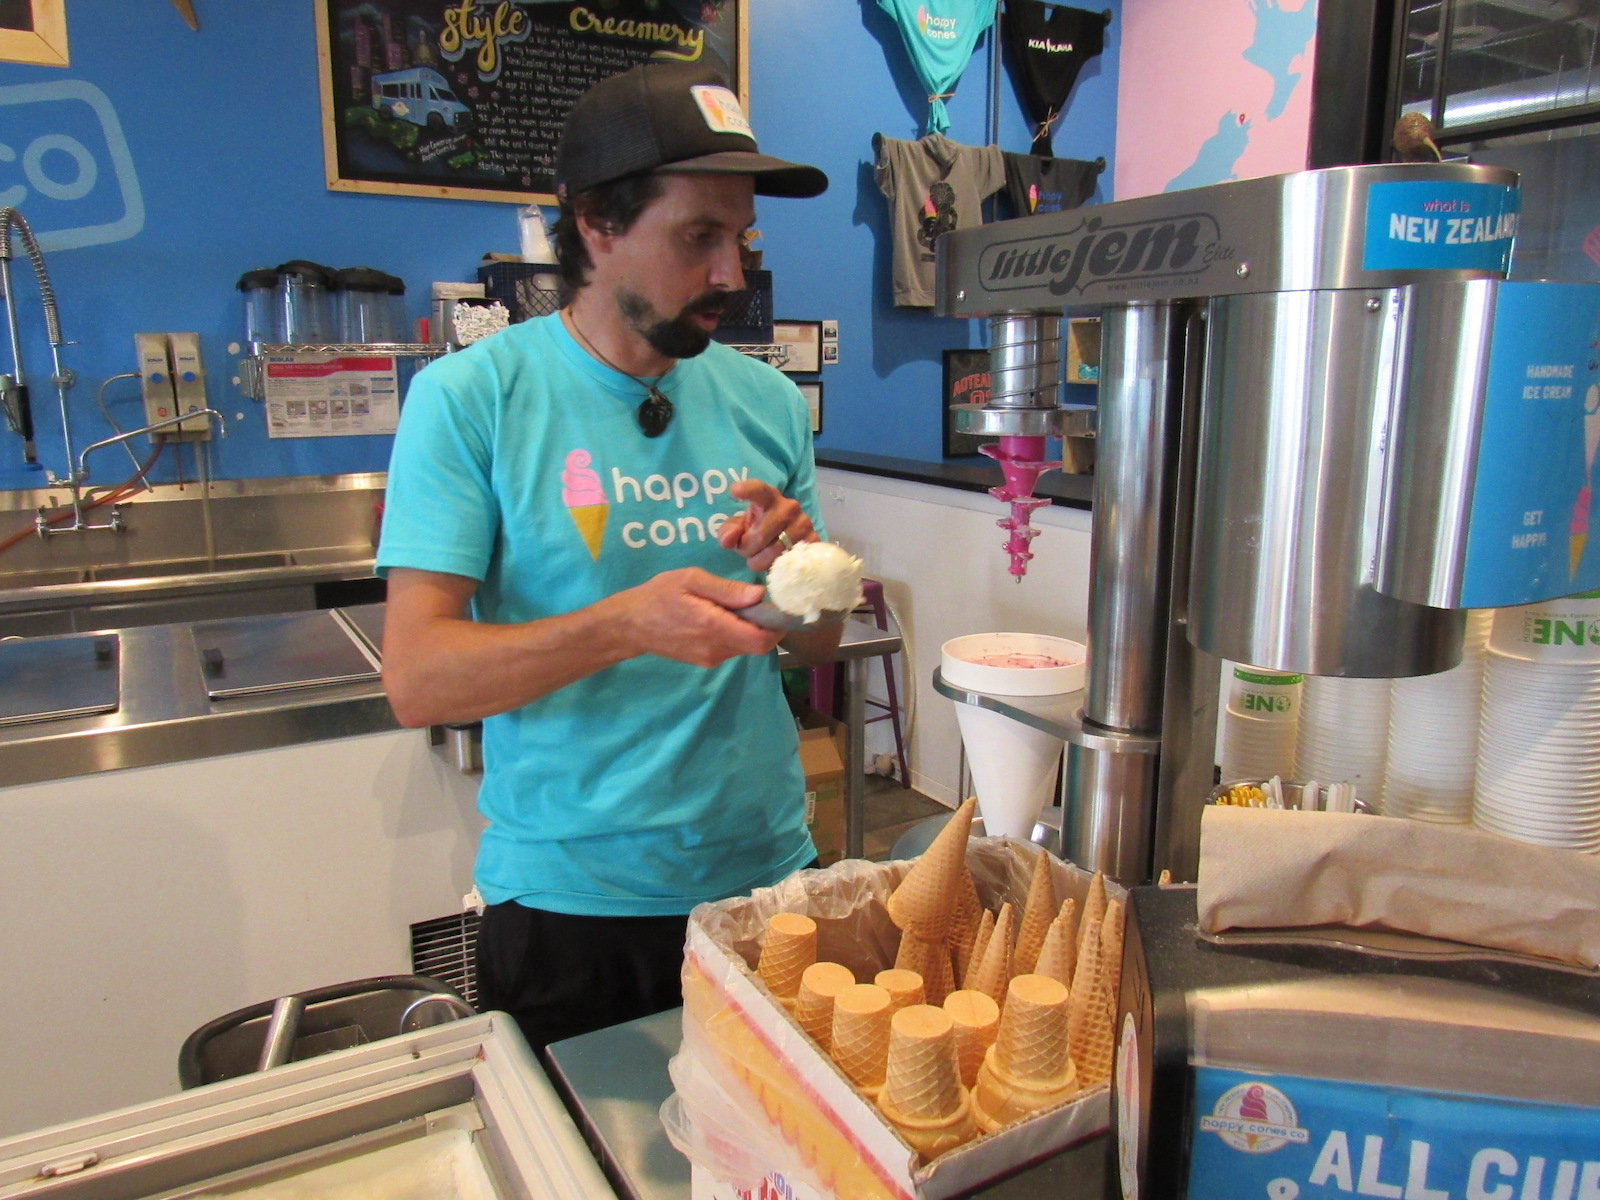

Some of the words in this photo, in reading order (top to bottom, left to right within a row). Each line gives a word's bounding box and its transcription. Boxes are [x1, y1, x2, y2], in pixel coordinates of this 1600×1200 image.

[926, 14, 956, 28] happy
[439, 0, 523, 73] style
[569, 7, 704, 62] Creamery
[926, 29, 956, 39] cones
[1028, 39, 1045, 50] KIA
[1051, 43, 1073, 53] KAHA
[1423, 200, 1456, 213] what
[1460, 201, 1470, 212] is
[1388, 212, 1439, 244] NEW
[1202, 243, 1234, 264] Elite
[1526, 365, 1574, 378] HANDMADE
[1522, 386, 1542, 400] ICE
[1543, 386, 1573, 400] CREAM
[1523, 511, 1543, 526] GET
[622, 511, 746, 549] cone
[1203, 1118, 1244, 1133] happy
[1249, 1124, 1287, 1136] cones
[1290, 1130, 1305, 1139] co
[1308, 1130, 1449, 1200] ALL
